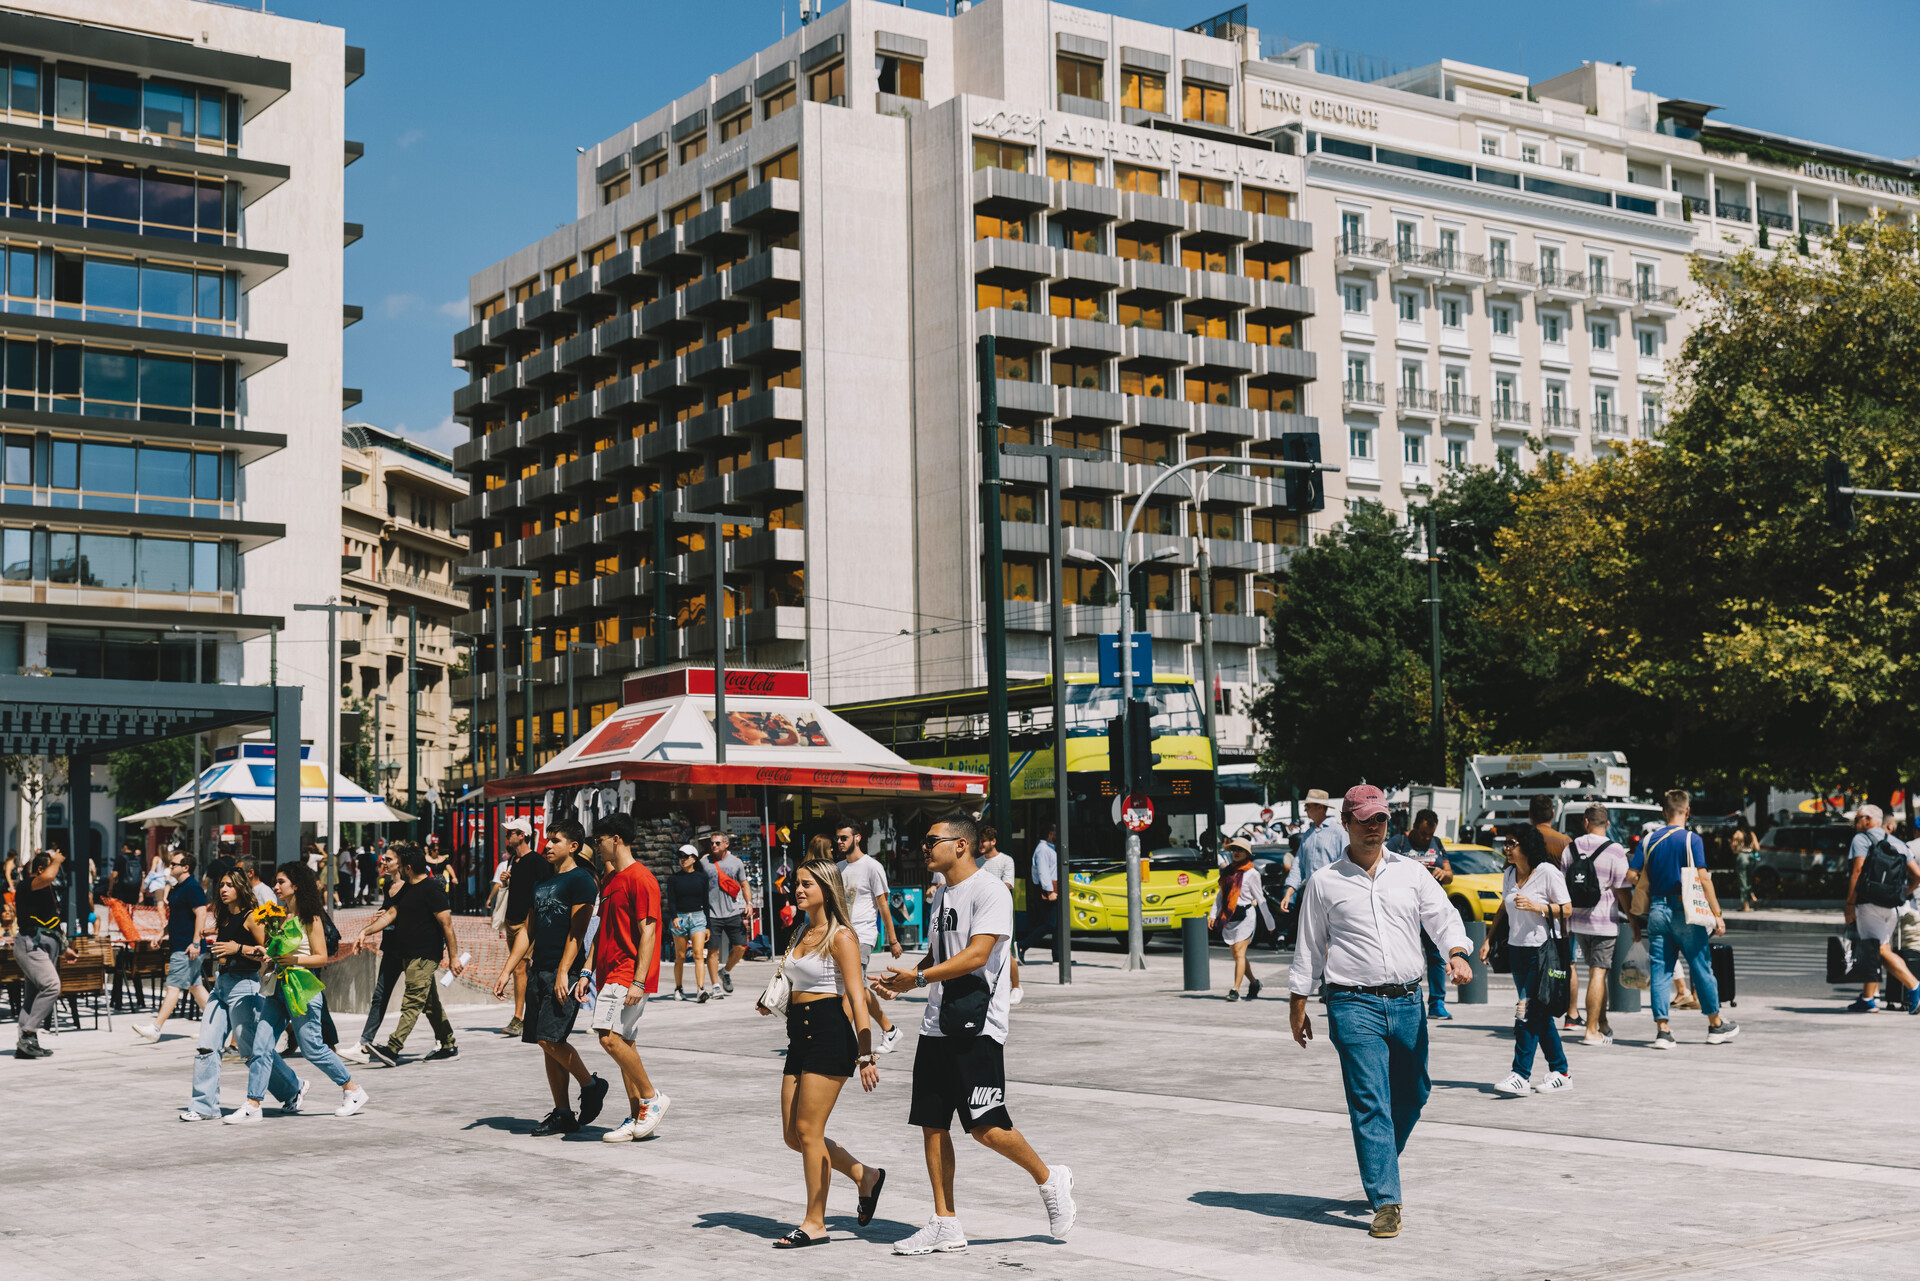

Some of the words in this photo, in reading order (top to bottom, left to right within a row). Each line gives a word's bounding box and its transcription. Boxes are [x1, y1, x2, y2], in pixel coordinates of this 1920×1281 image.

[1260, 88, 1302, 114] KING
[1310, 99, 1379, 130] GEORGE
[1055, 118, 1183, 164] ATHENS
[1190, 140, 1290, 184] PLAZA
[1804, 161, 1854, 184] HOTEL
[1855, 172, 1915, 197] GRANDE
[971, 1086, 1002, 1105] NIKE
